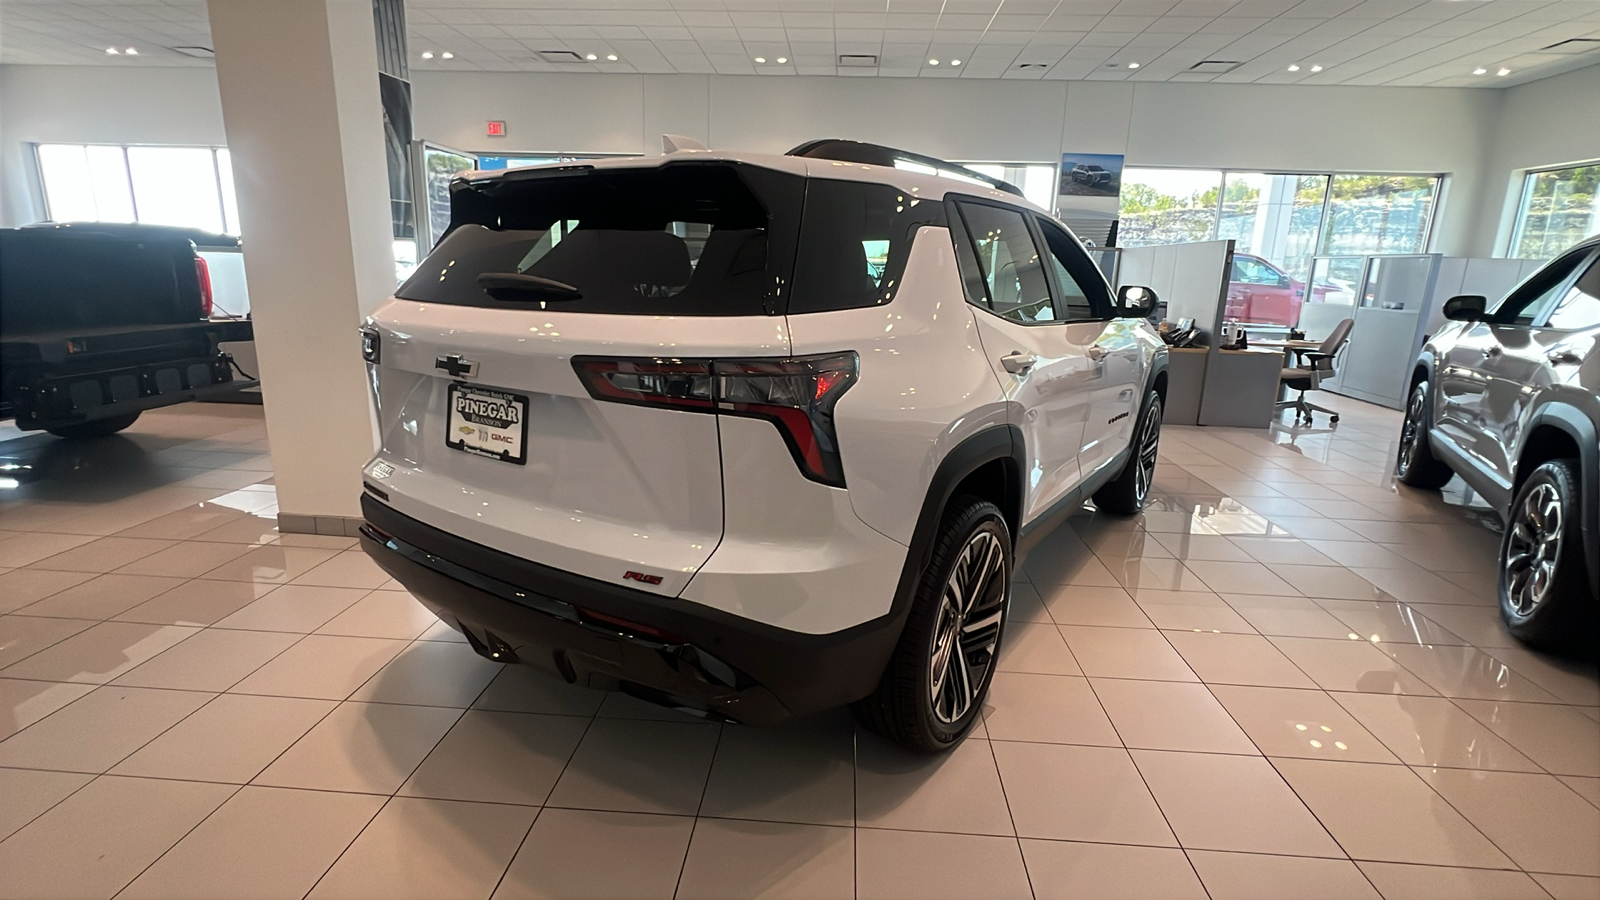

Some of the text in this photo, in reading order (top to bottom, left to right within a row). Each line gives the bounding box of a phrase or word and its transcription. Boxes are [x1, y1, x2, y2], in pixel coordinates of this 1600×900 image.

[488, 122, 502, 134] EXIT
[457, 398, 519, 423] PINEGAR
[491, 433, 514, 444] GMC
[622, 570, 664, 586] RS
